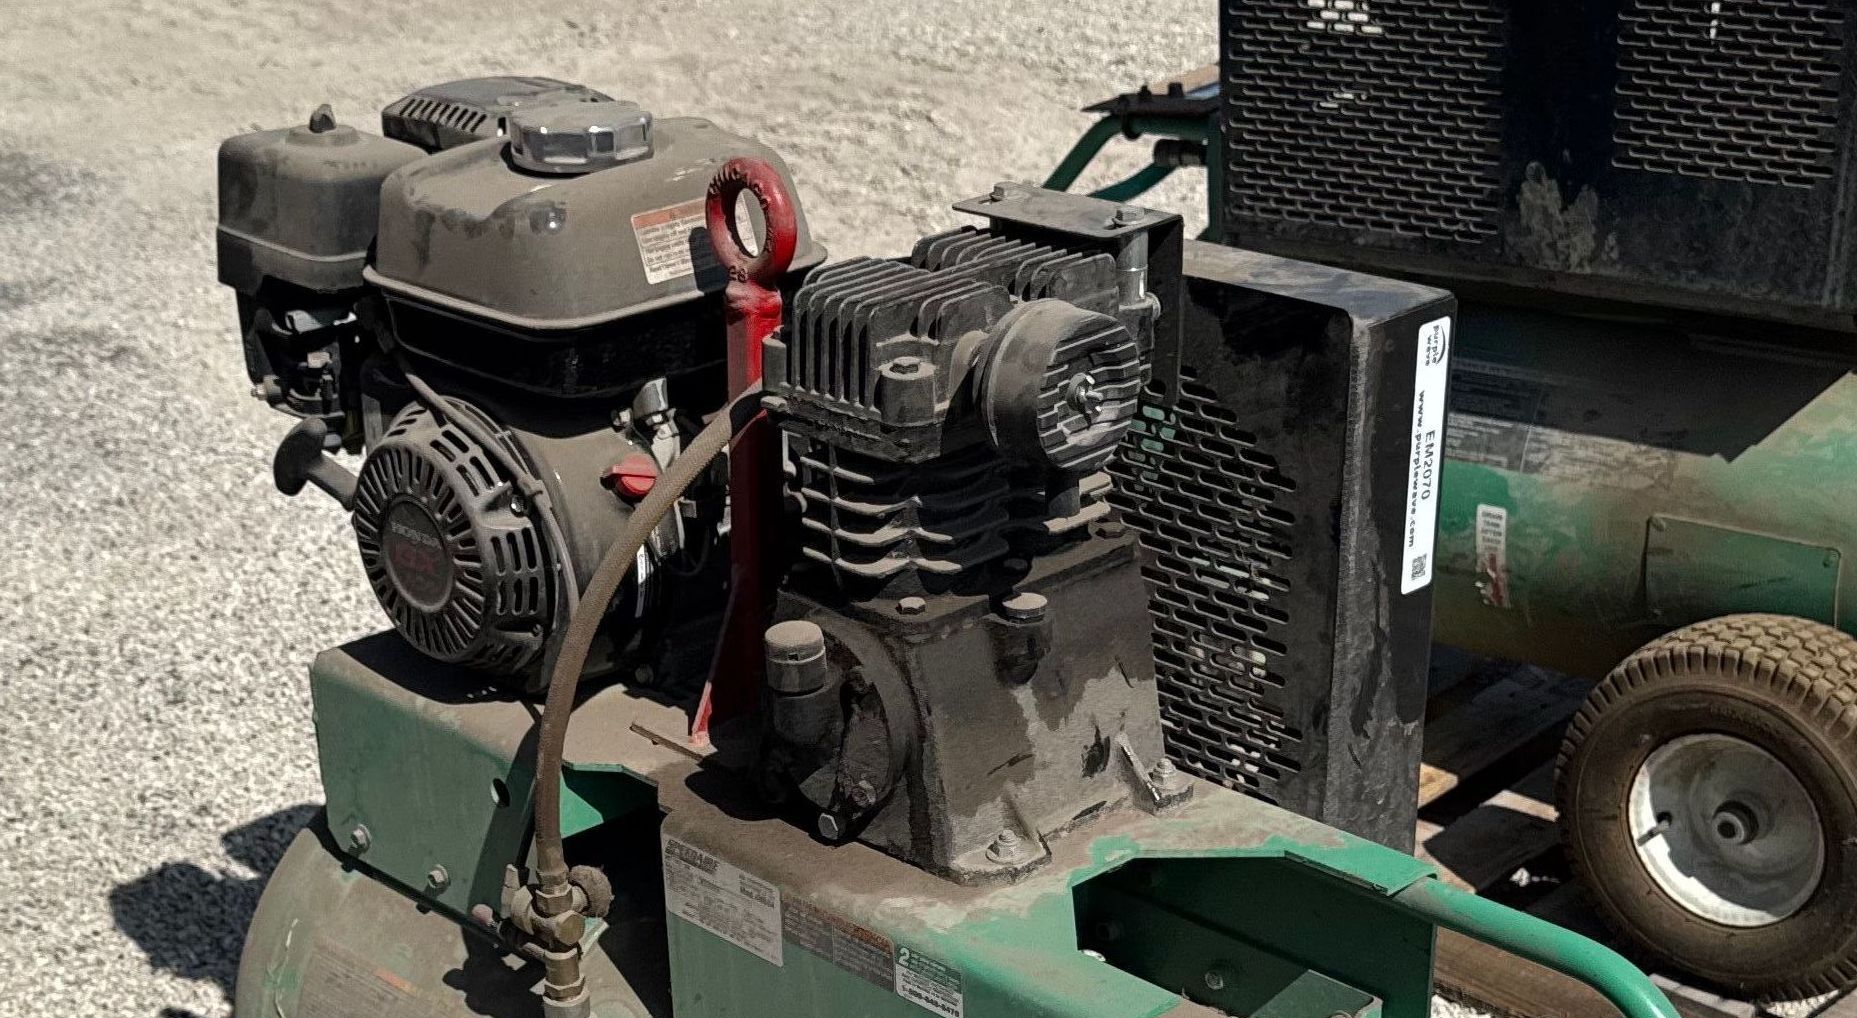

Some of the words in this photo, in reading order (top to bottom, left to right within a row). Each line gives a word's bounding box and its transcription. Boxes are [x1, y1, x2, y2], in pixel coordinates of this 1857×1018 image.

[1425, 334, 1433, 366] wave
[1432, 324, 1441, 364] purple
[1408, 390, 1425, 548] www.purplewave.com
[1421, 430, 1436, 500] EM2070
[898, 947, 910, 967] 2
